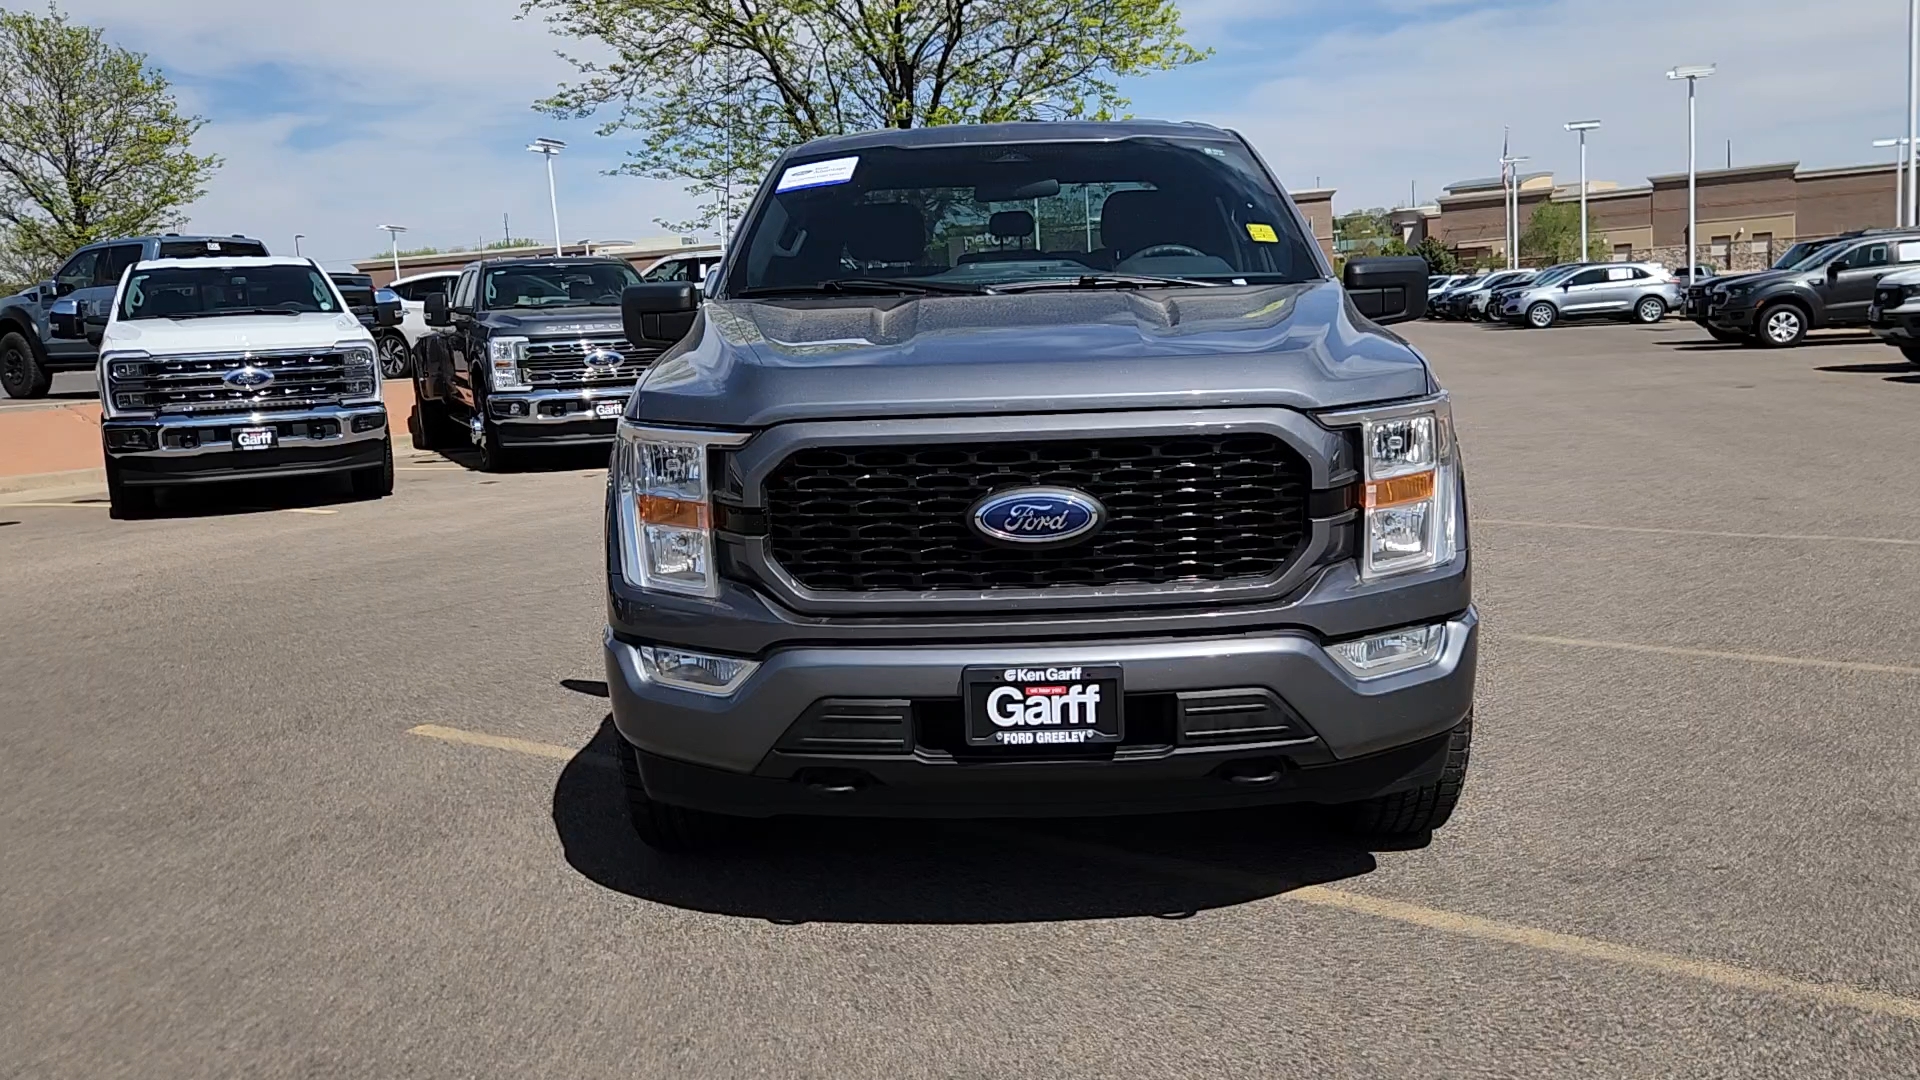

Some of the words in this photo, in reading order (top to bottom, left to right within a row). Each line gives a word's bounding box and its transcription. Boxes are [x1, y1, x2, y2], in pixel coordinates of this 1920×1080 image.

[595, 404, 622, 415] Garff
[238, 432, 272, 446] Garff
[1004, 504, 1070, 532] Ford
[1017, 668, 1045, 682] Ken
[1046, 667, 1083, 681] Garff
[986, 684, 1100, 727] Garff
[1003, 732, 1034, 744] FORD
[1036, 731, 1086, 743] GREELEY
